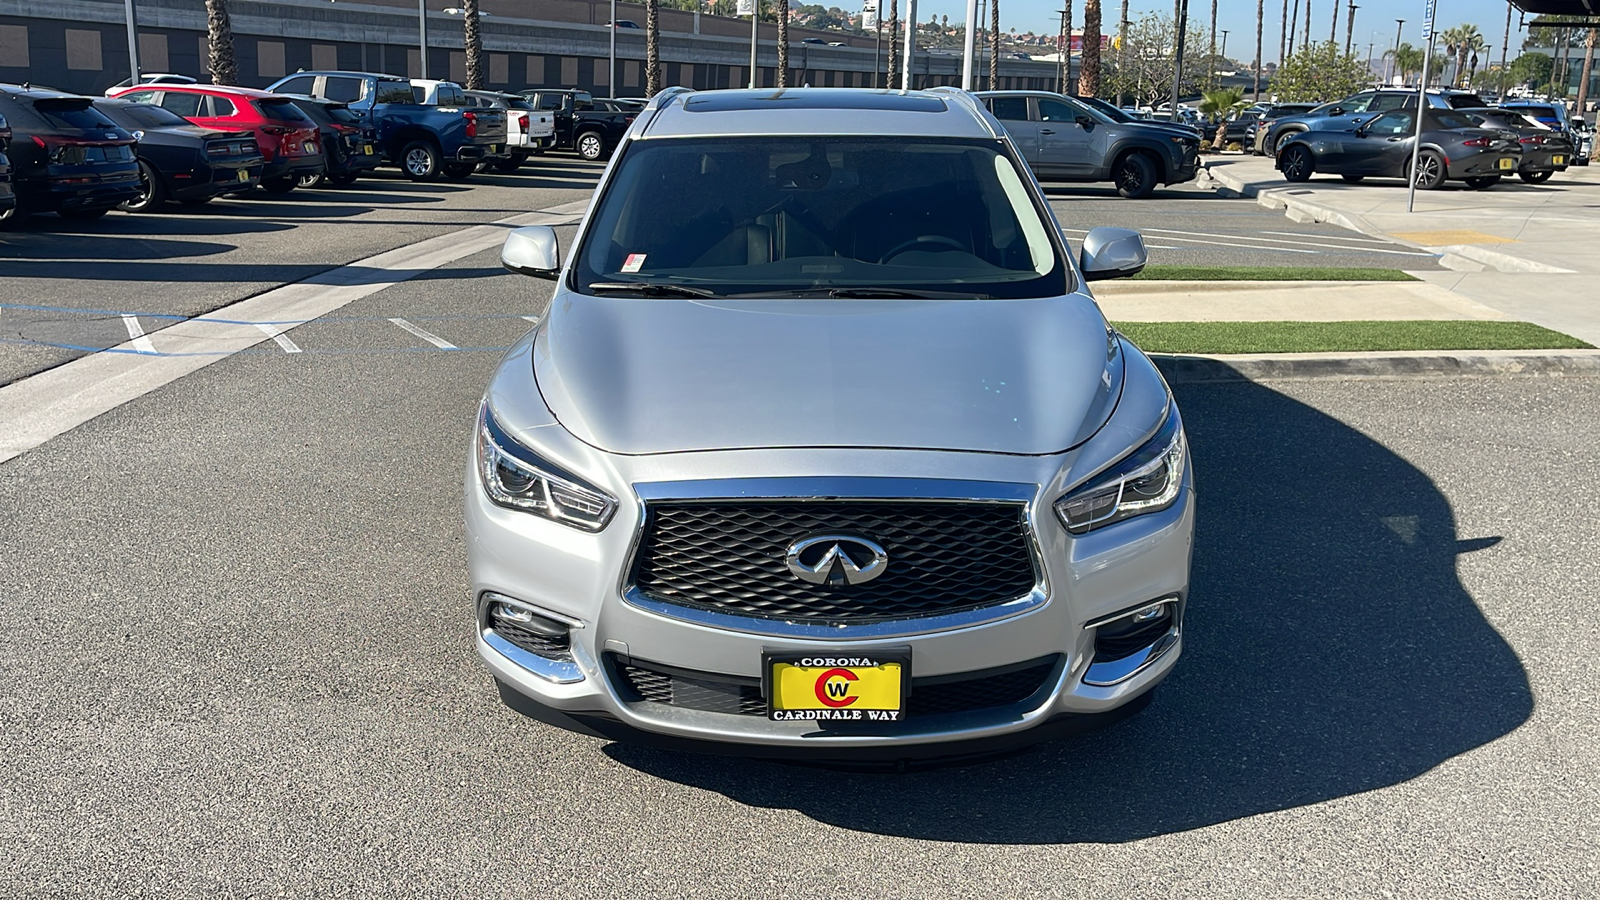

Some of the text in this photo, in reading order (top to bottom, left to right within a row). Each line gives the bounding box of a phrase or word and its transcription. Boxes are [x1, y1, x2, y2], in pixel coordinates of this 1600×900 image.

[801, 657, 872, 667] CORONA
[814, 668, 860, 708] C
[827, 682, 849, 697] W
[773, 710, 900, 721] CARDINALE WAY
